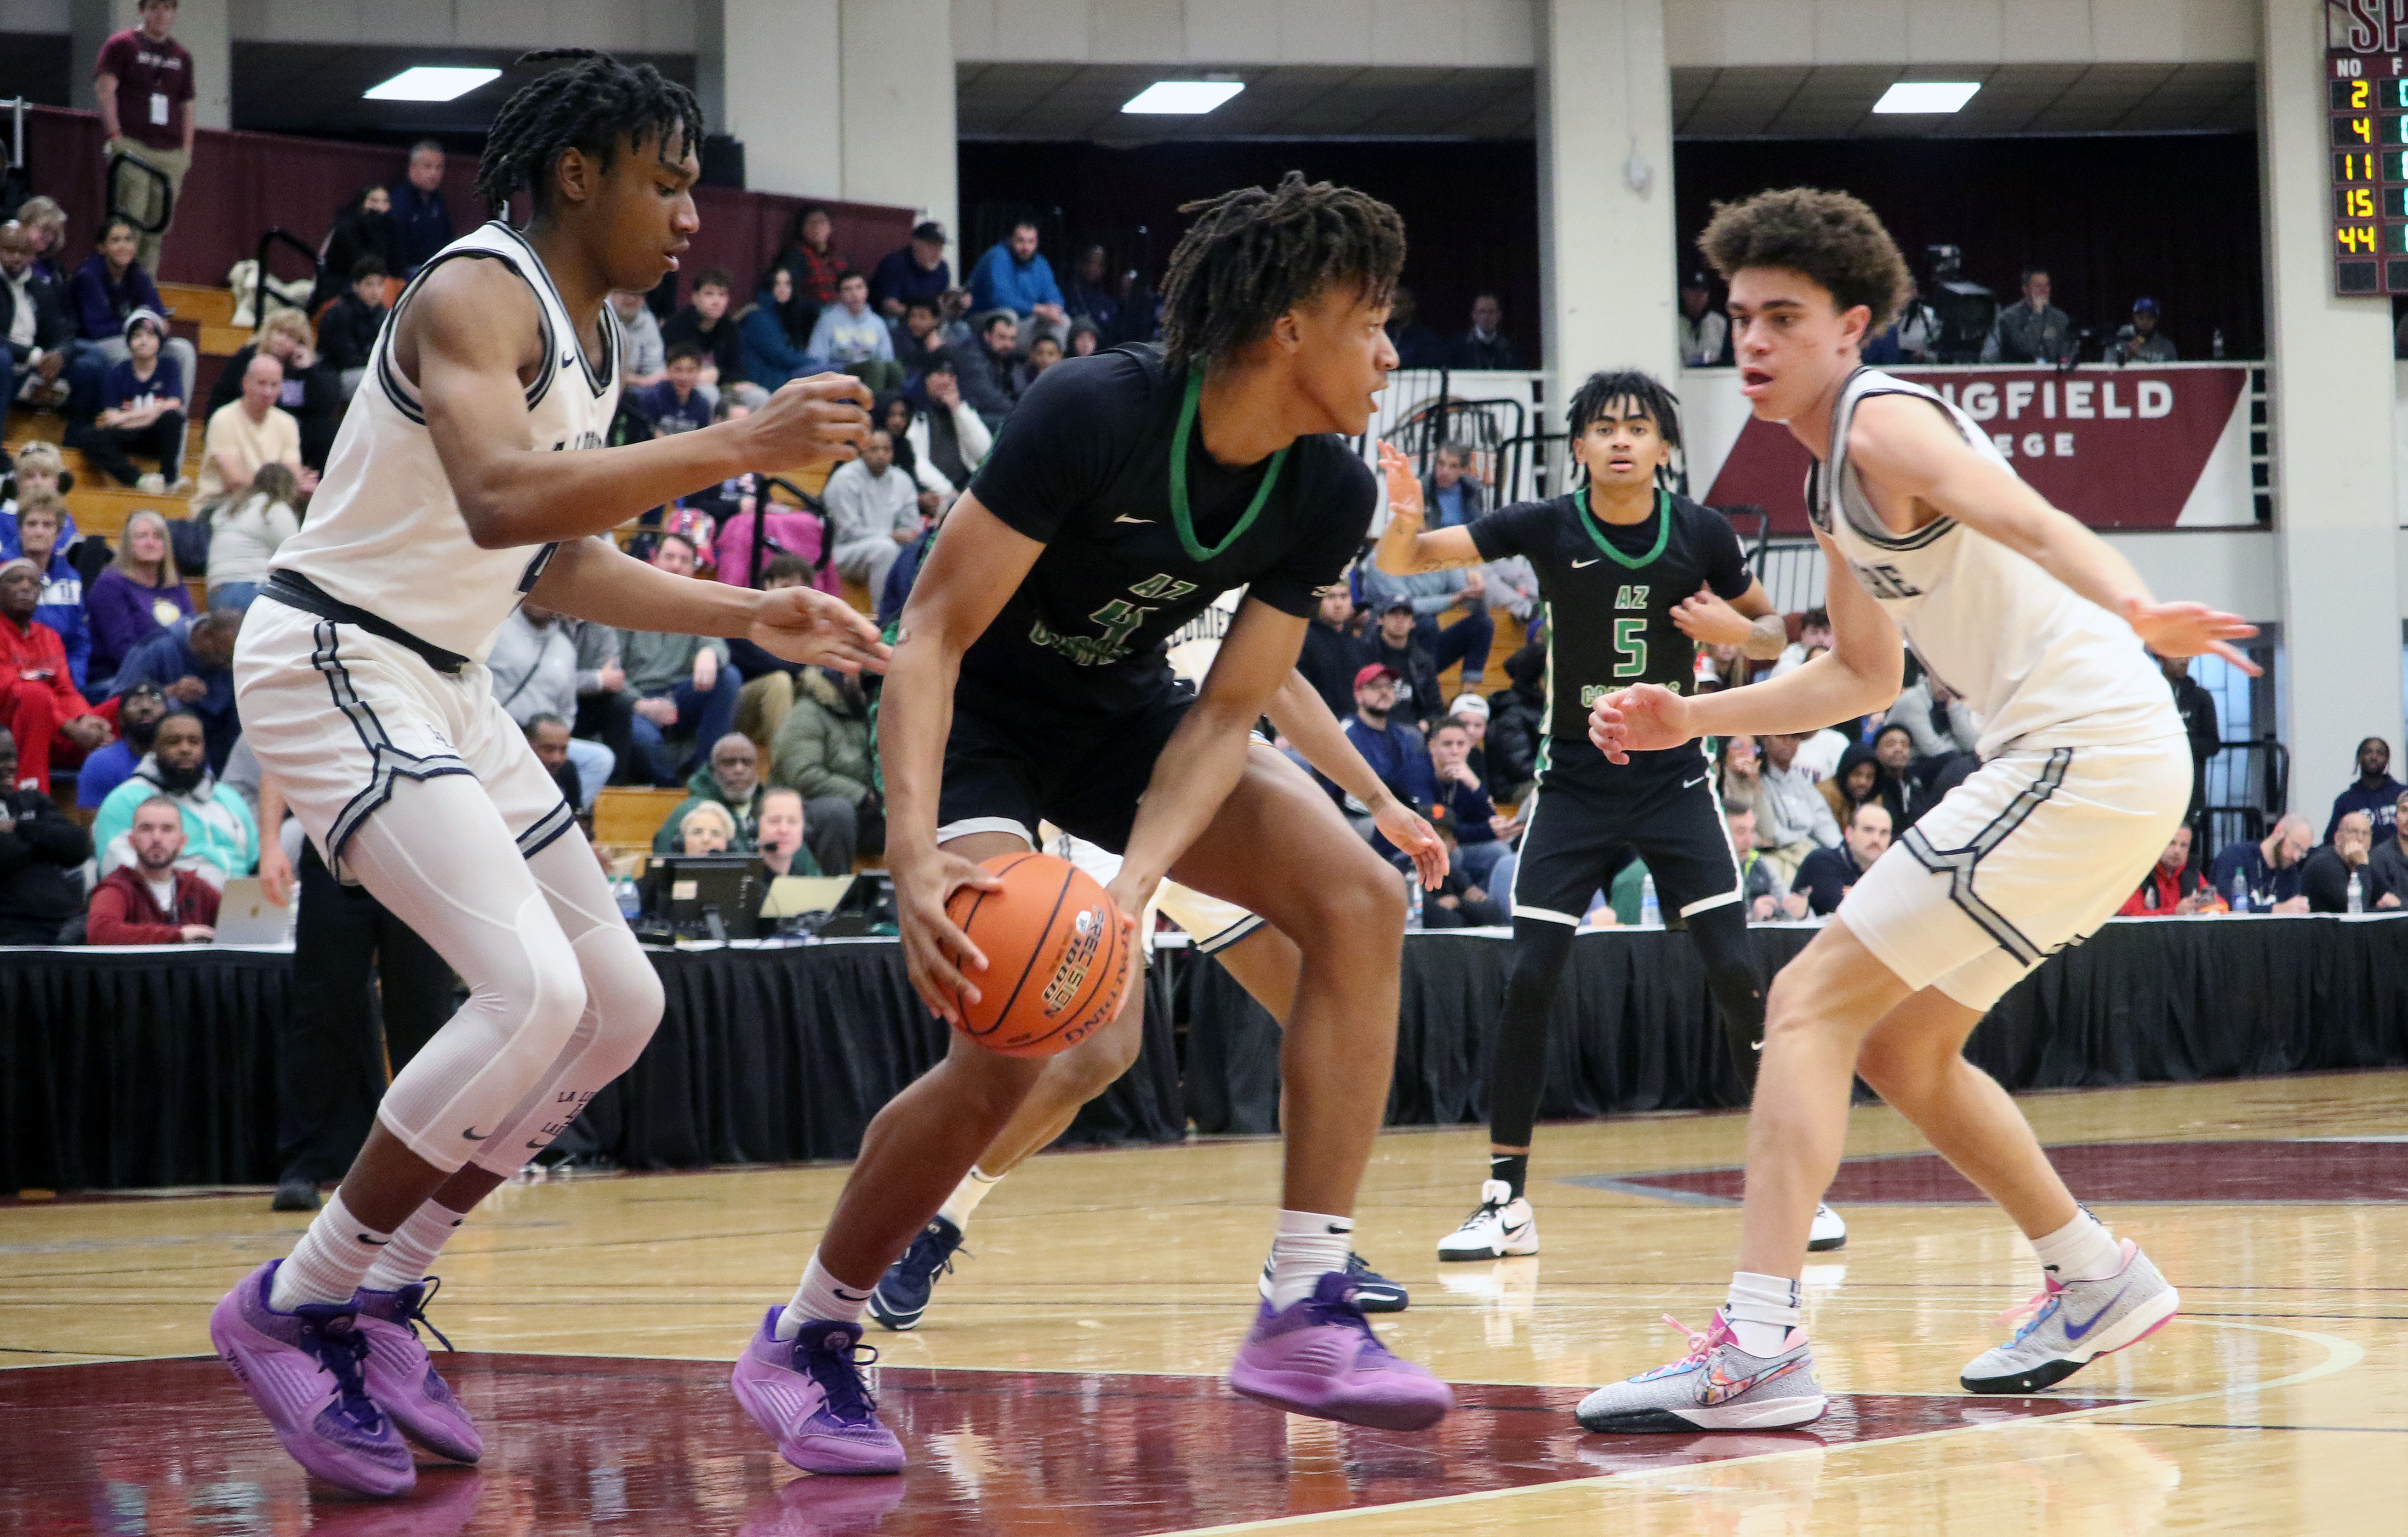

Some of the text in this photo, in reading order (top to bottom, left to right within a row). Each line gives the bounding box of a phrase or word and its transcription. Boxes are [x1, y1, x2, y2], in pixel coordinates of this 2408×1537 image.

[2336, 57, 2403, 77] NO F
[2351, 80, 2368, 109] 2
[2352, 117, 2370, 144] 4
[2345, 152, 2372, 180] 11
[2346, 189, 2374, 217] 15
[2338, 226, 2375, 253] 44
[1128, 573, 1198, 600] AZ
[1614, 585, 1650, 610] AZ
[1614, 618, 1648, 677] 5
